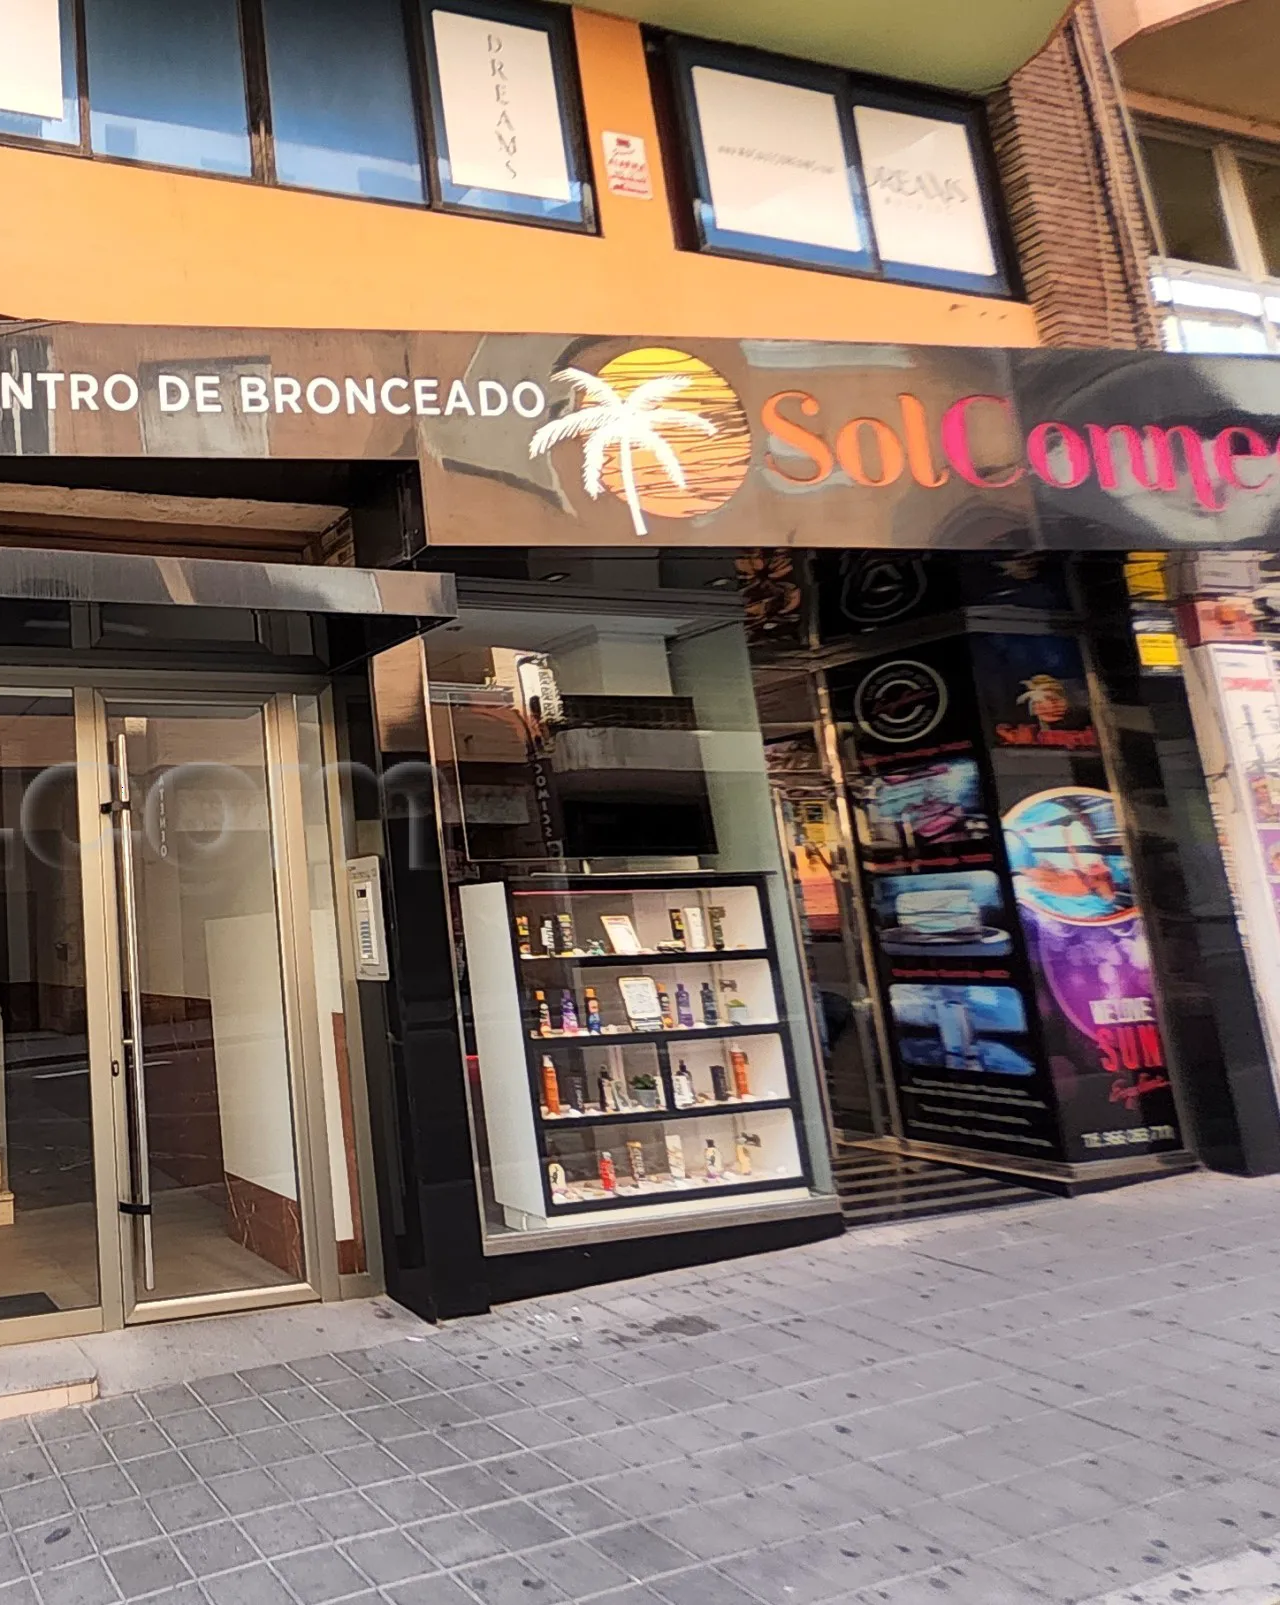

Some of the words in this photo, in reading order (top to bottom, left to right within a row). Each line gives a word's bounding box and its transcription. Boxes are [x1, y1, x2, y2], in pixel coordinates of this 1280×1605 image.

[486, 34, 518, 180] DREAMS
[158, 373, 224, 413] DE
[240, 376, 546, 419] BRONCEADO
[760, 389, 1280, 513] SolConne
[1096, 1023, 1163, 1073] SUN
